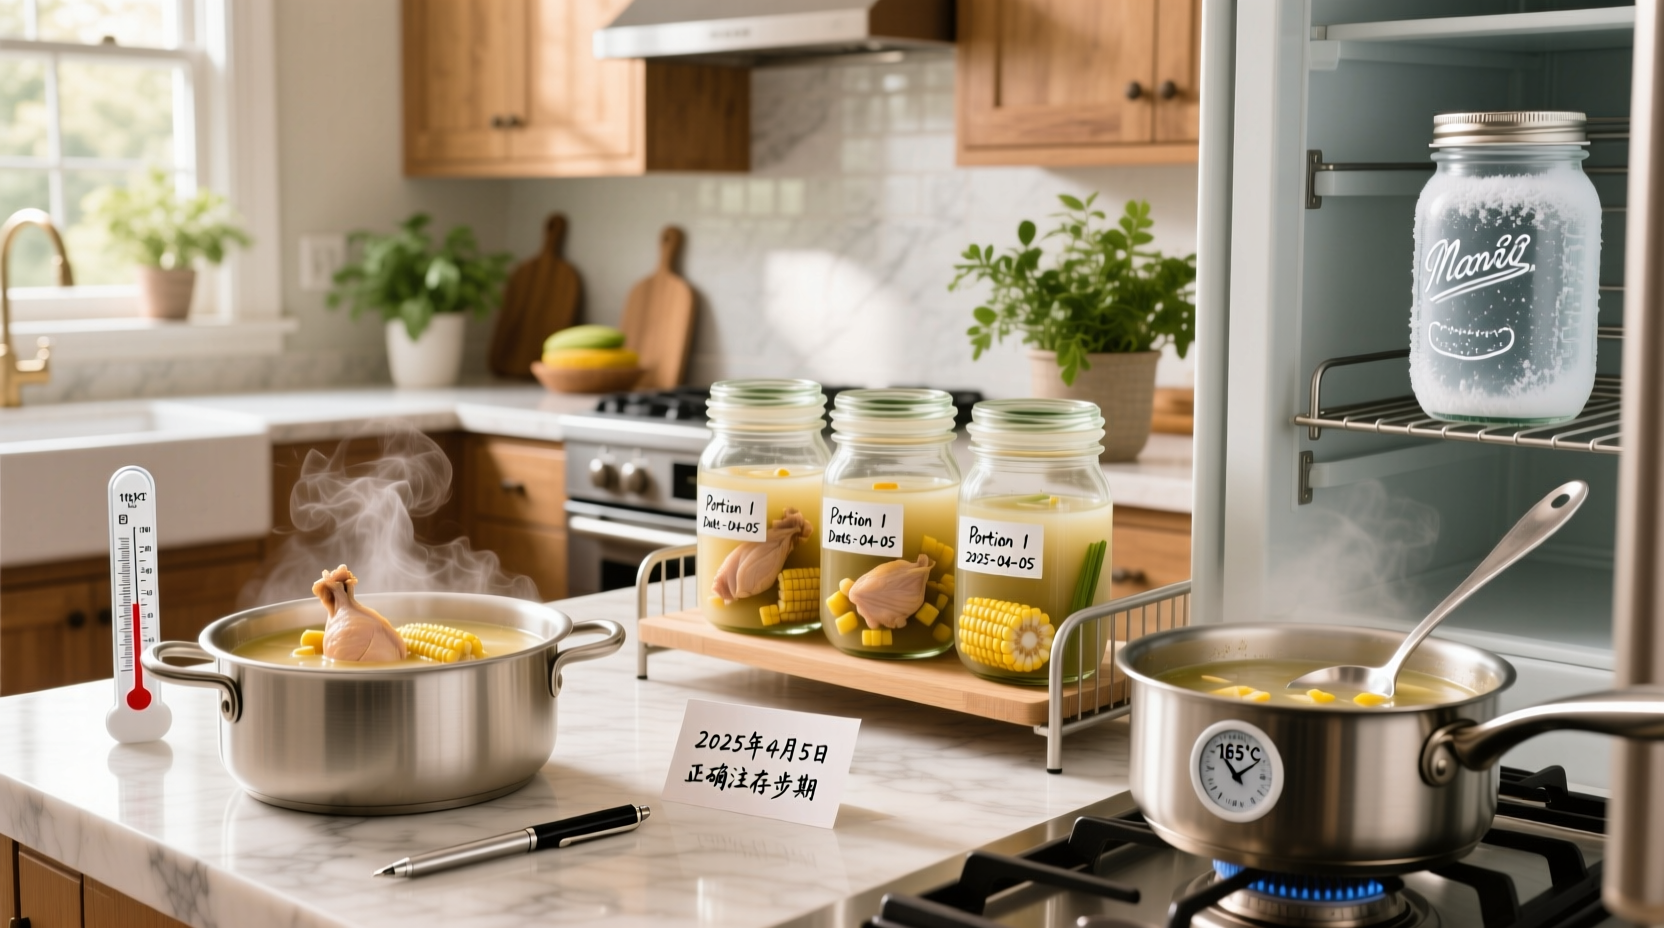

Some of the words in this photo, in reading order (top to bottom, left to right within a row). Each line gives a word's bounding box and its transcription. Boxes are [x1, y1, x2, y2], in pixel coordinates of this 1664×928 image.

[749, 501, 755, 516] 1
[830, 506, 872, 528] Portion
[881, 513, 887, 529] 1
[969, 525, 1014, 549] Portion
[1023, 533, 1029, 550] 1
[965, 551, 1036, 570] 2025-04-05
[694, 730, 829, 764] 2025年4月5日
